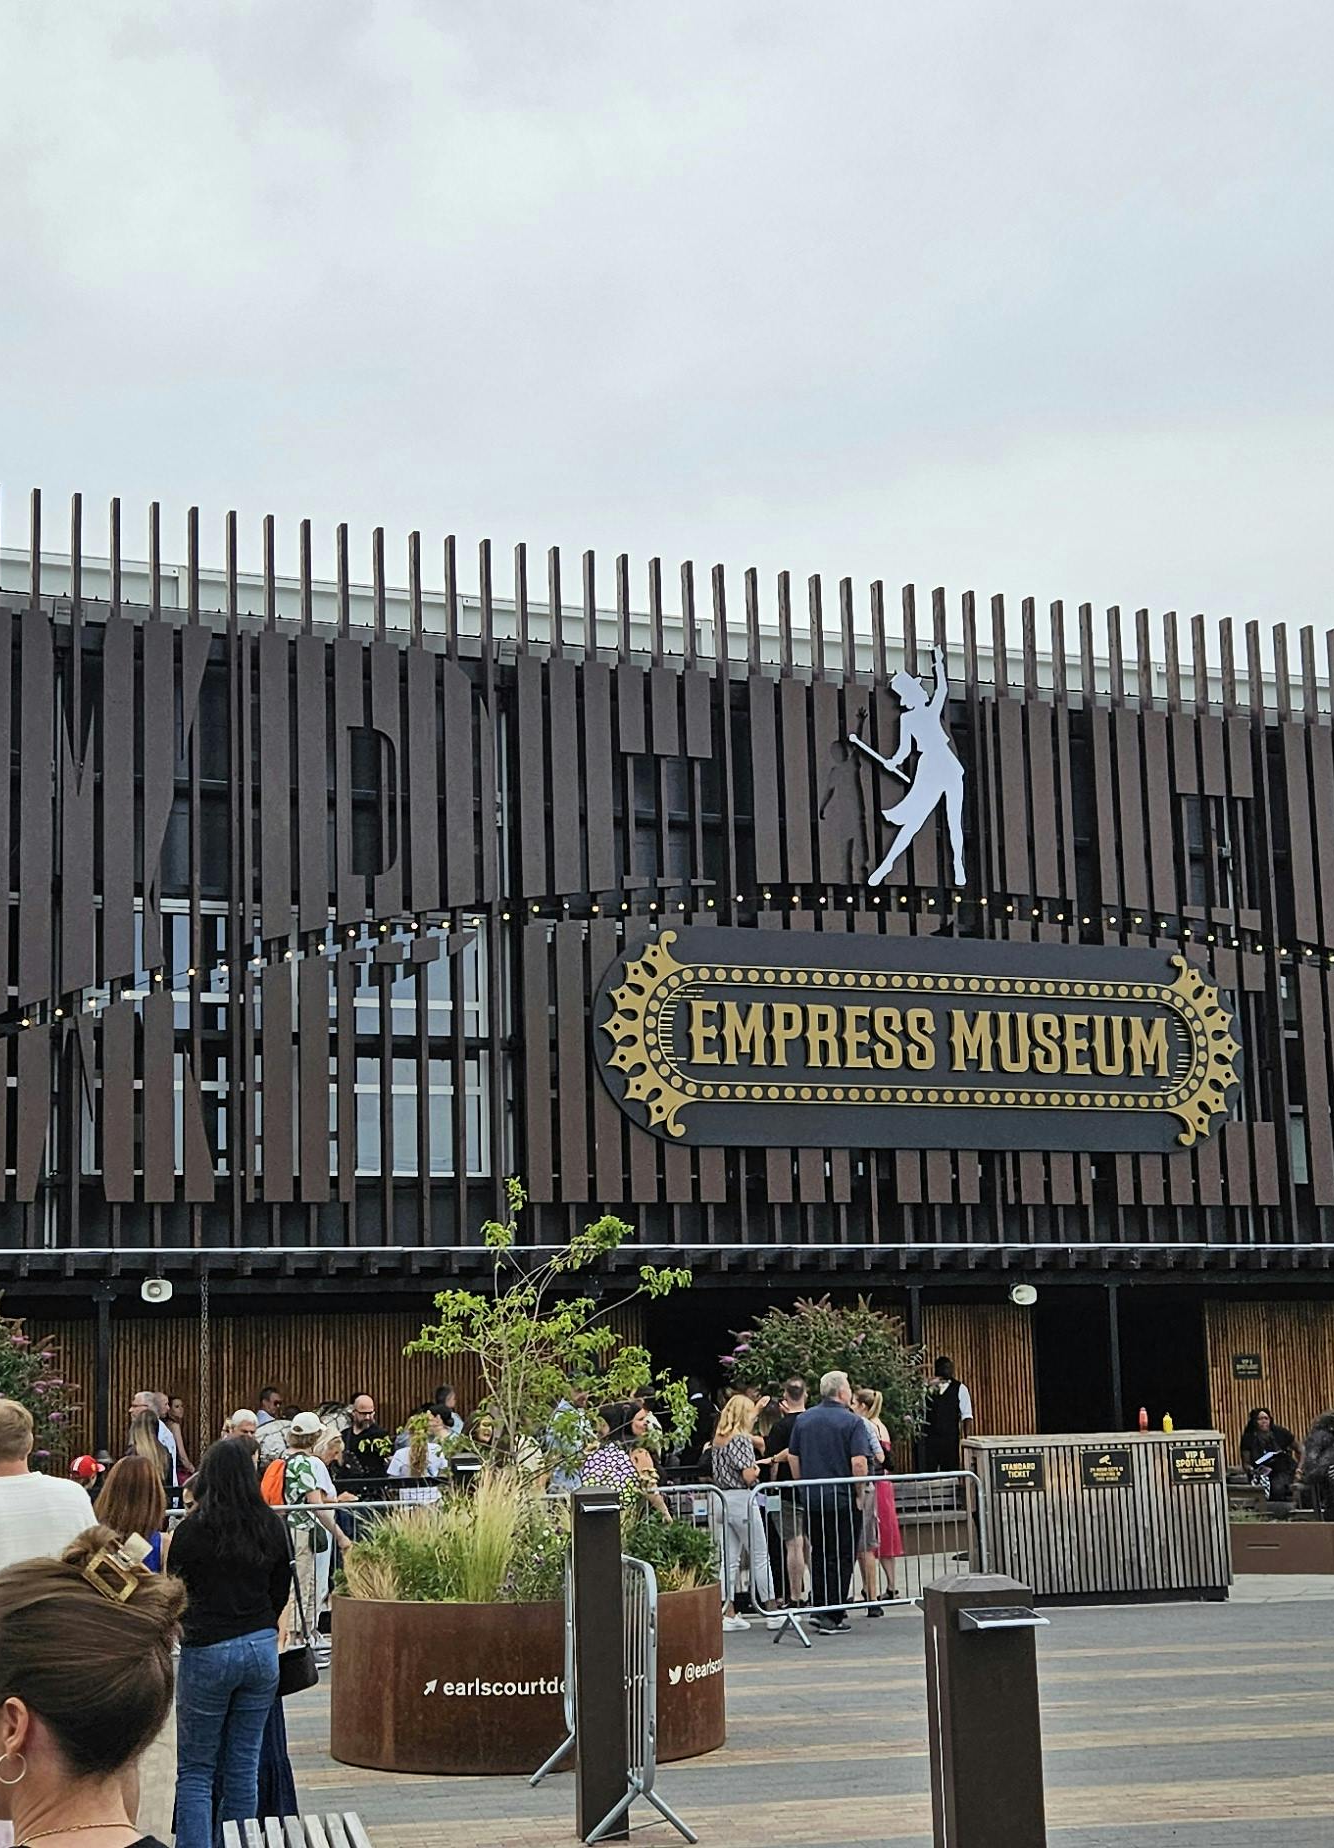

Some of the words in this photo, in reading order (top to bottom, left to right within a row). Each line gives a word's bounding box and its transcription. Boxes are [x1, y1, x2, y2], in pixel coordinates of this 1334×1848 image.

[687, 1000, 937, 1071] EMPRESS
[949, 1008, 1170, 1078] MUSEUM
[1184, 1450, 1198, 1459] VIP
[1001, 1462, 1036, 1472] STANDARD
[1175, 1457, 1216, 1468] SPOTLIGHT
[1008, 1470, 1031, 1479] TICKET
[443, 1676, 566, 1696] earlscourtde
